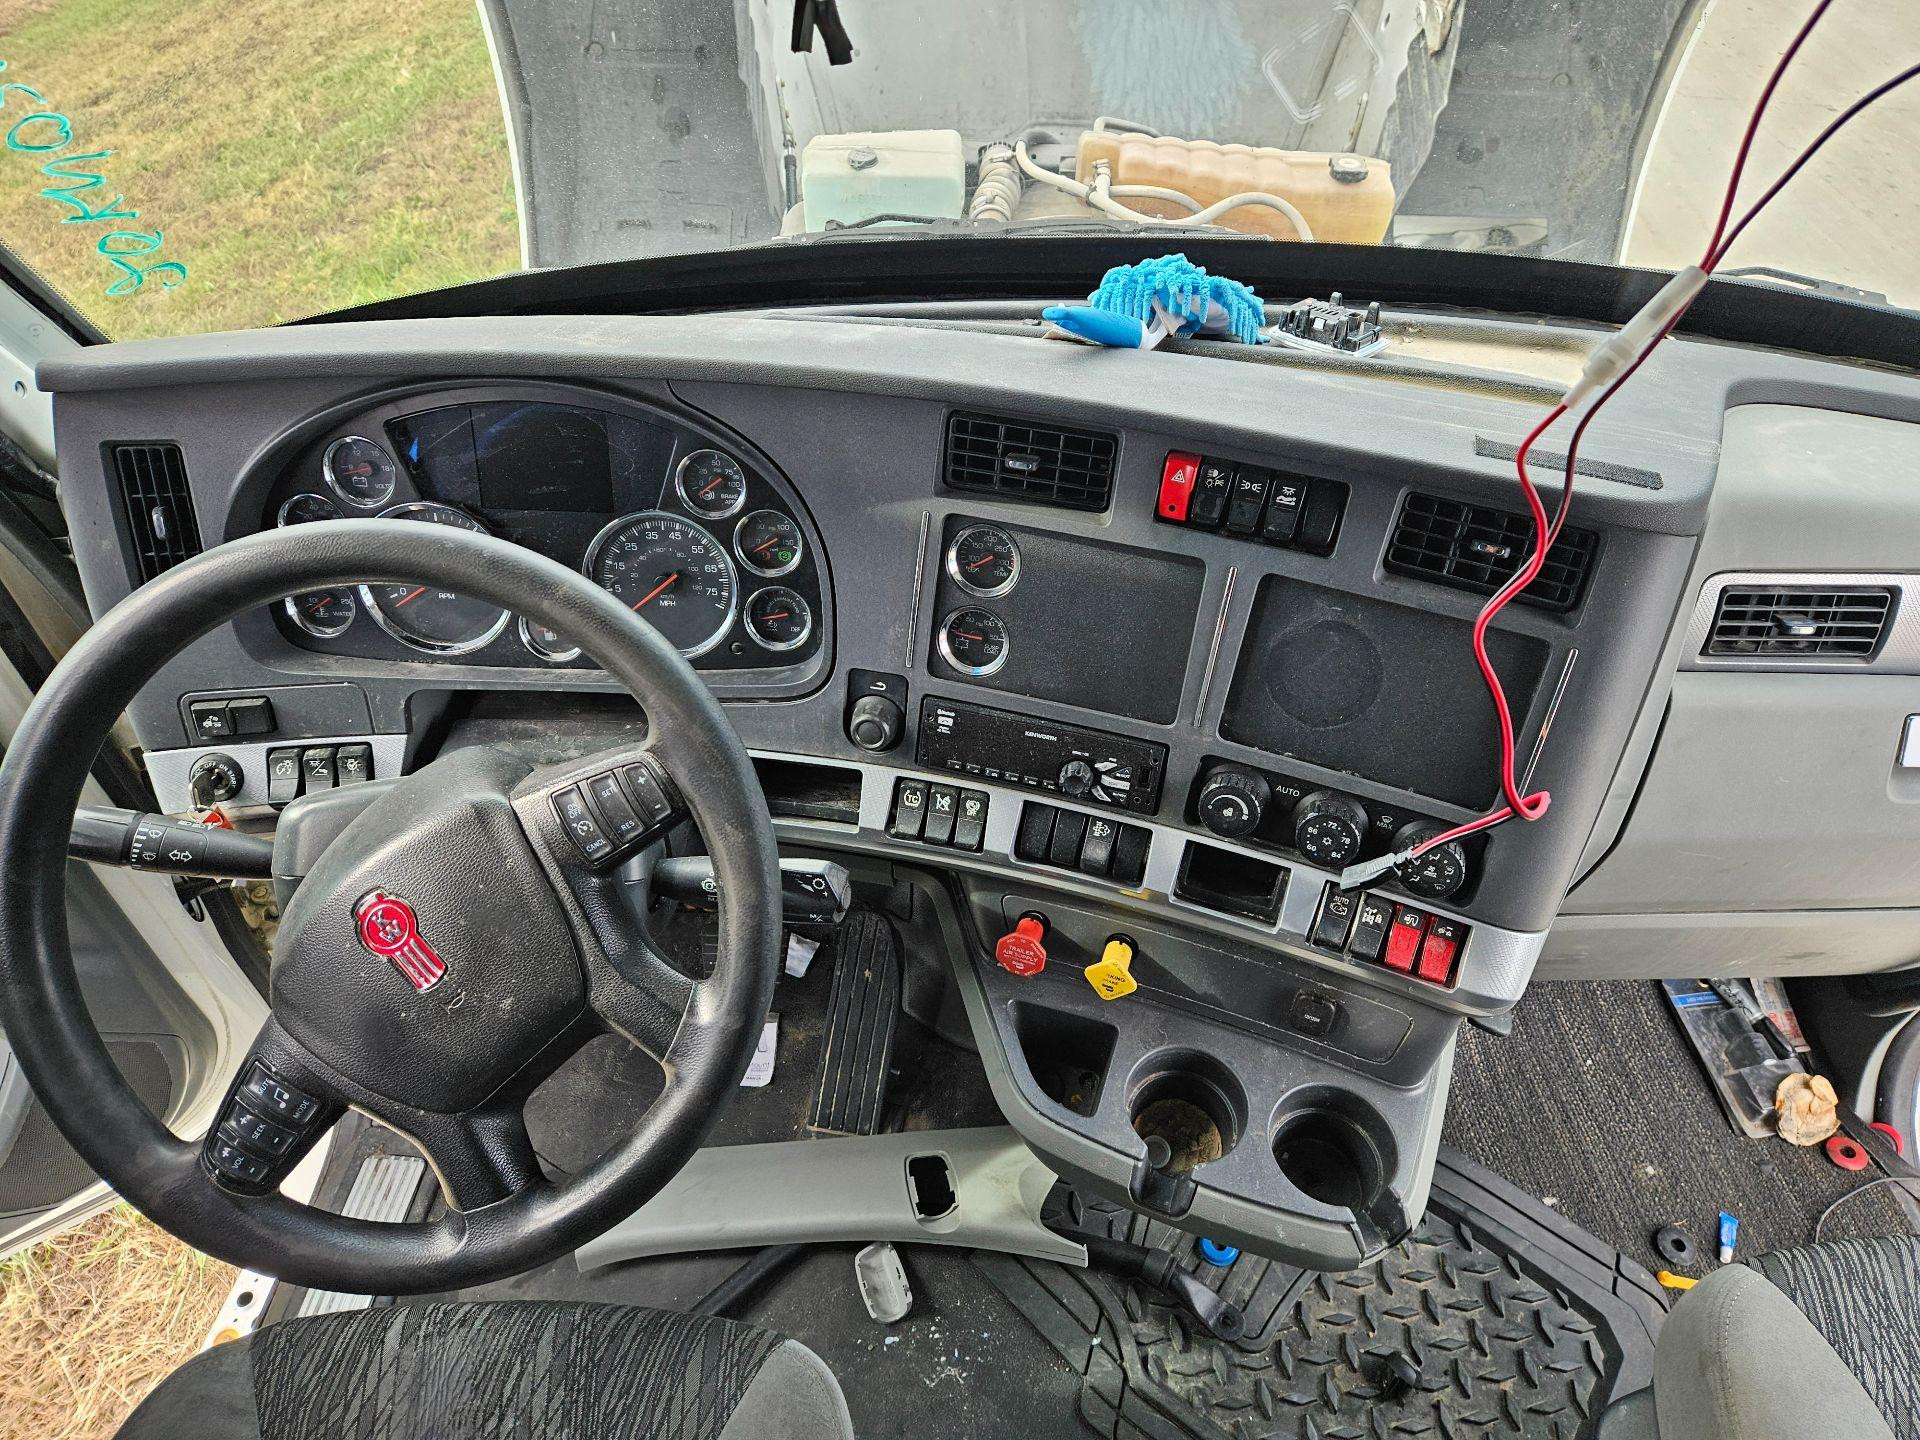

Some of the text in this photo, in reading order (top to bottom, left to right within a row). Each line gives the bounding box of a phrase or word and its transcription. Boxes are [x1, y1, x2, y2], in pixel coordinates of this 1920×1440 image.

[645, 531, 659, 540] 35
[668, 531, 682, 540] 45
[624, 543, 638, 551] 25
[691, 545, 704, 554] 55
[613, 562, 625, 570] 15
[704, 564, 718, 572] 65
[400, 587, 407, 595] 0
[1024, 730, 1057, 741] KENWORTH
[601, 787, 616, 798] SET
[1276, 785, 1300, 797] AUTO
[907, 794, 918, 803] TC
[567, 809, 582, 819] OFF
[621, 820, 635, 831] RES
[1327, 821, 1337, 830] 72
[1376, 820, 1393, 831] MAX
[1307, 826, 1318, 835] 66
[586, 838, 607, 852] CANCL
[1341, 836, 1350, 845] 78
[1306, 843, 1317, 852] 60
[1333, 895, 1350, 904] AUTO
[1009, 945, 1034, 957] TRAILER
[258, 1078, 270, 1096] MUTE
[292, 1100, 310, 1119] MODE
[252, 1123, 267, 1140] SEEK
[231, 1156, 245, 1169] VOL
